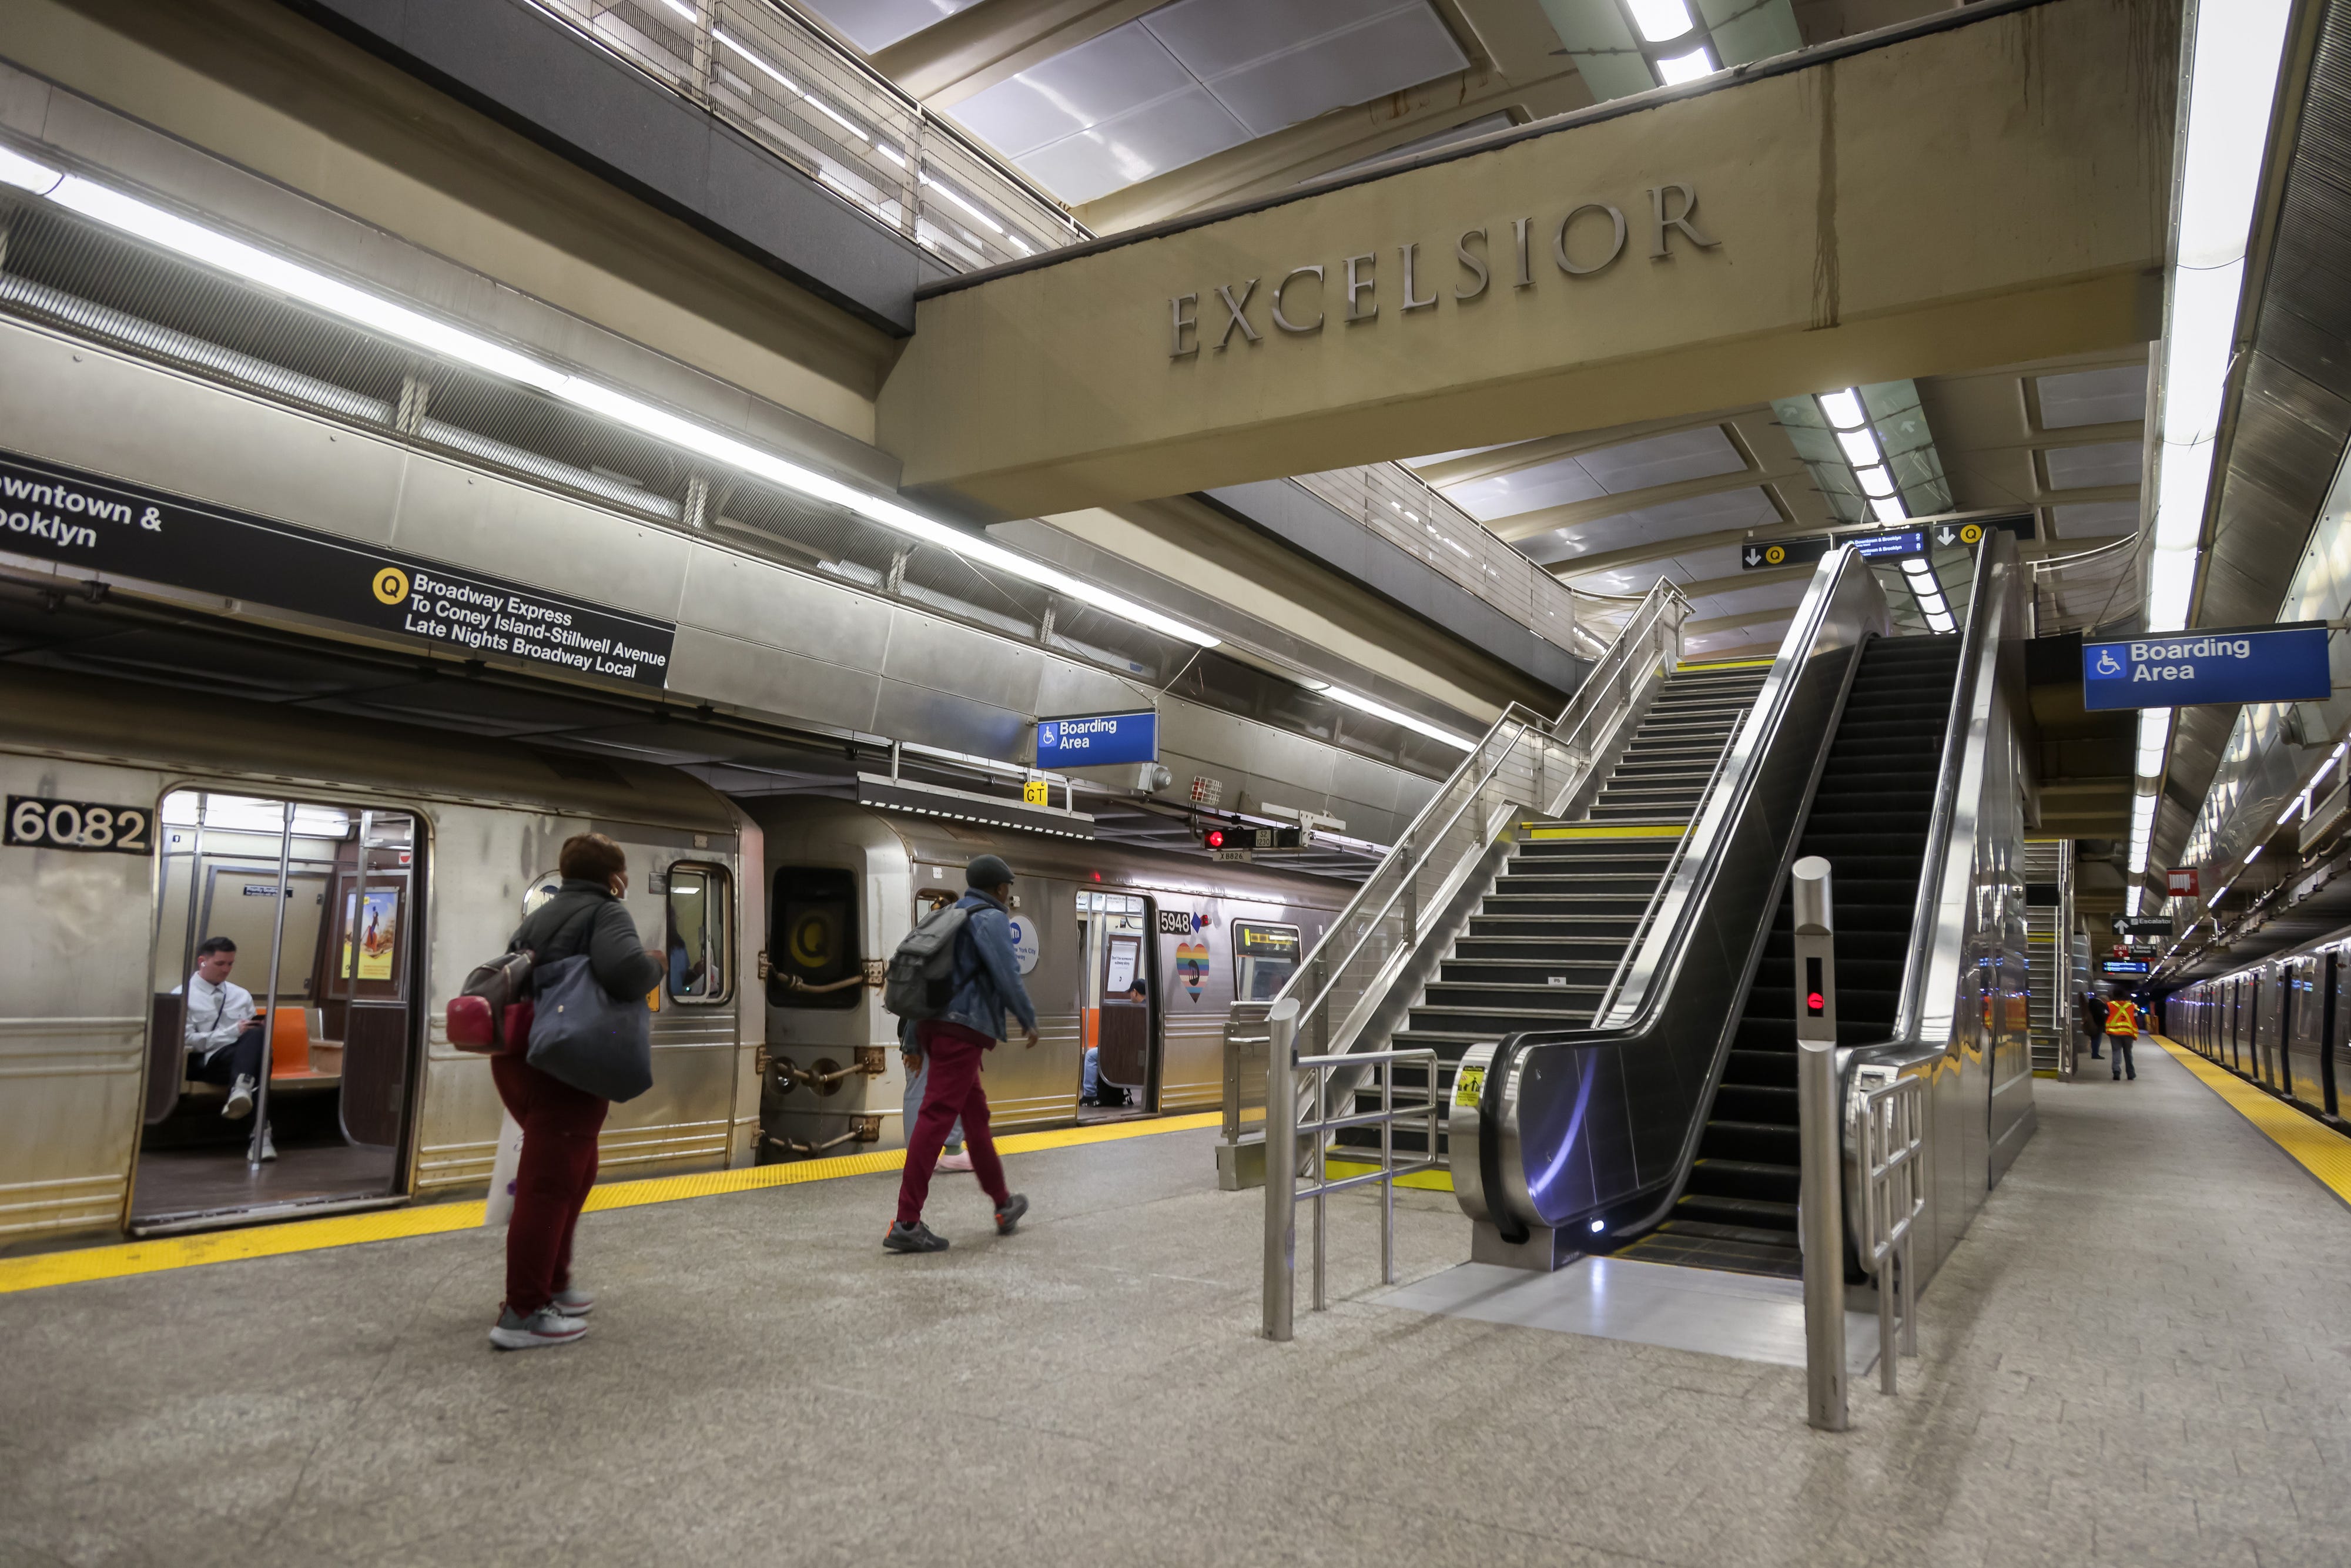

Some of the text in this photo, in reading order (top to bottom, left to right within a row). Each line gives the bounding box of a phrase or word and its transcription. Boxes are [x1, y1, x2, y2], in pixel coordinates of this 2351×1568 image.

[1168, 182, 1722, 359] EXCELSIOR
[0, 476, 162, 531] wntown &
[381, 575, 400, 598] Q
[413, 574, 572, 626] Broadway Express
[405, 614, 637, 678] Late Nights Broadway Local
[410, 594, 667, 667] To Coney Island-Stillwell Avenue
[2131, 638, 2250, 662] Boarding
[2133, 664, 2195, 682] Area
[1060, 719, 1117, 735] Boarding
[1060, 736, 1090, 749] Area
[12, 800, 146, 849] 6082
[1161, 912, 1190, 933] 5948
